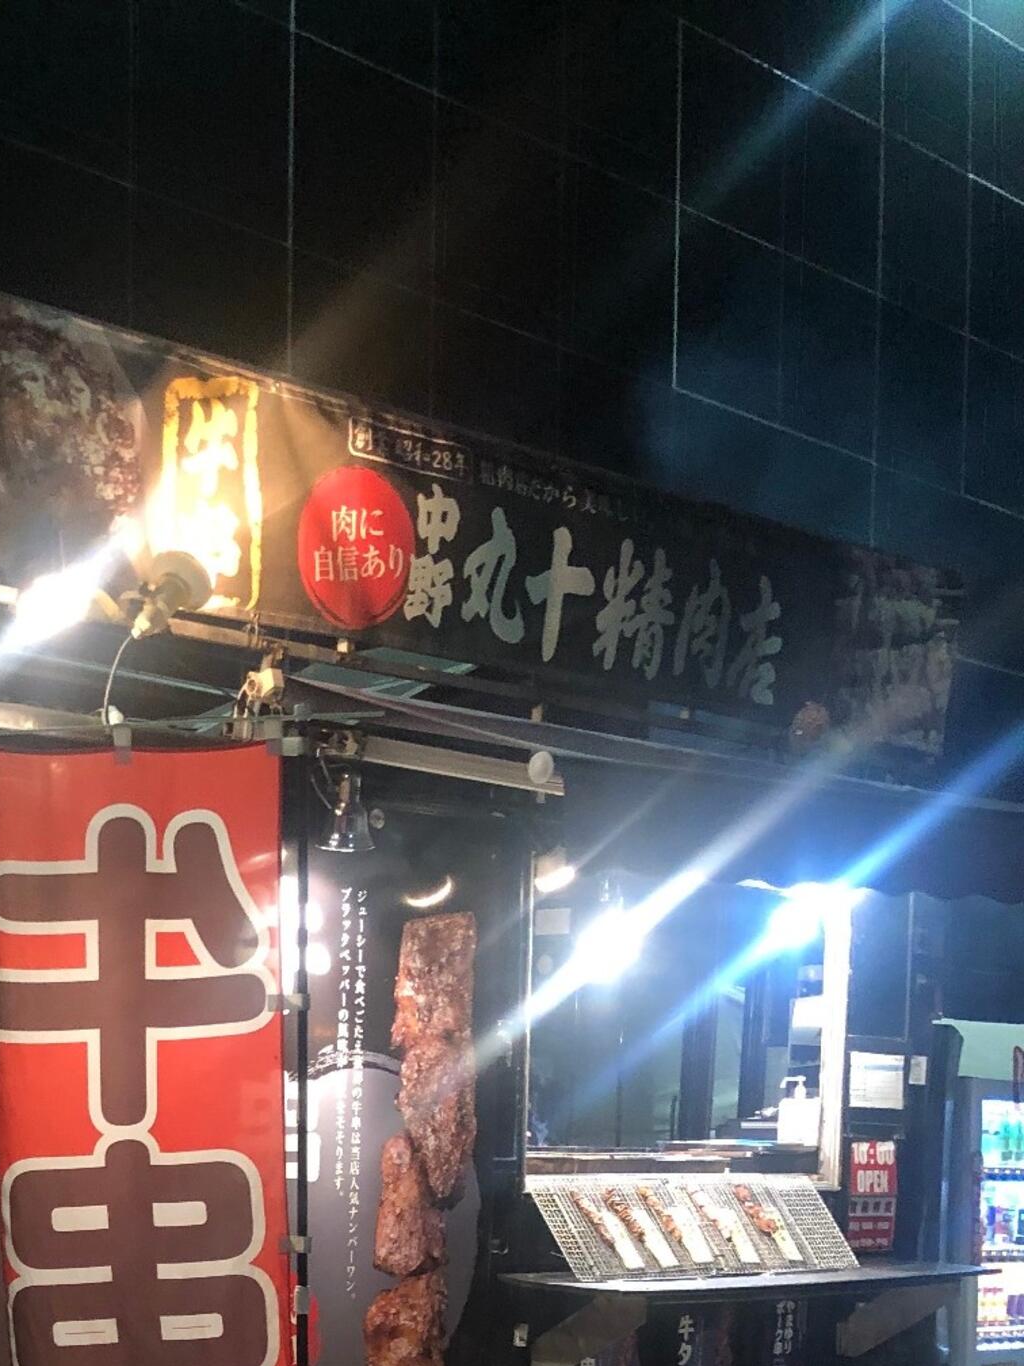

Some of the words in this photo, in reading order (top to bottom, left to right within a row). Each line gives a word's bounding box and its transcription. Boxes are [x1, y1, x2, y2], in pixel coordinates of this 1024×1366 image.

[332, 504, 385, 541] 肉に
[313, 543, 404, 583] 自信あり
[461, 505, 784, 706] 丸十精肉店
[856, 1169, 889, 1193] OPEN
